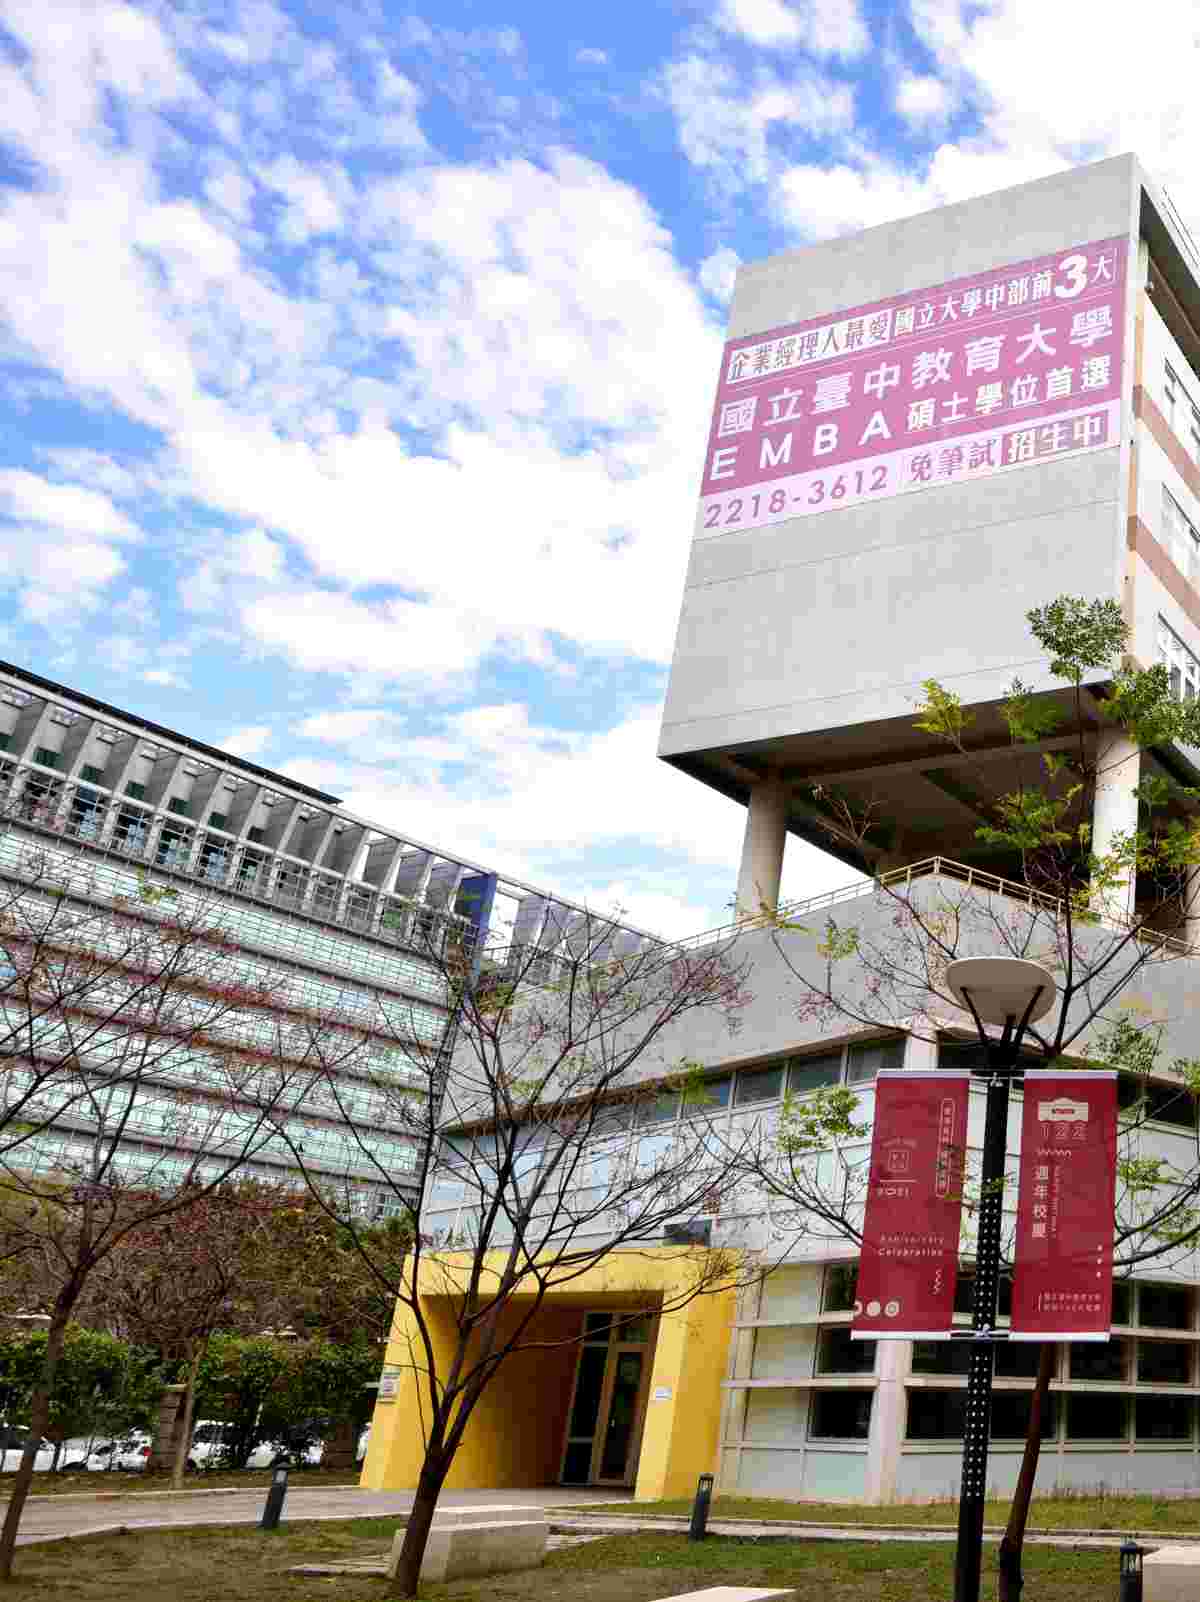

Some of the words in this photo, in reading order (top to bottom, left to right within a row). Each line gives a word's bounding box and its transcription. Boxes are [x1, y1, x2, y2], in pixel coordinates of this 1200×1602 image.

[718, 305, 1112, 438] 國立臺中教育大學
[907, 355, 1111, 431] 碩士學位首選
[704, 465, 888, 528] 2218-3612
[911, 438, 995, 481] 免筆試
[1008, 415, 1102, 463] 招生中
